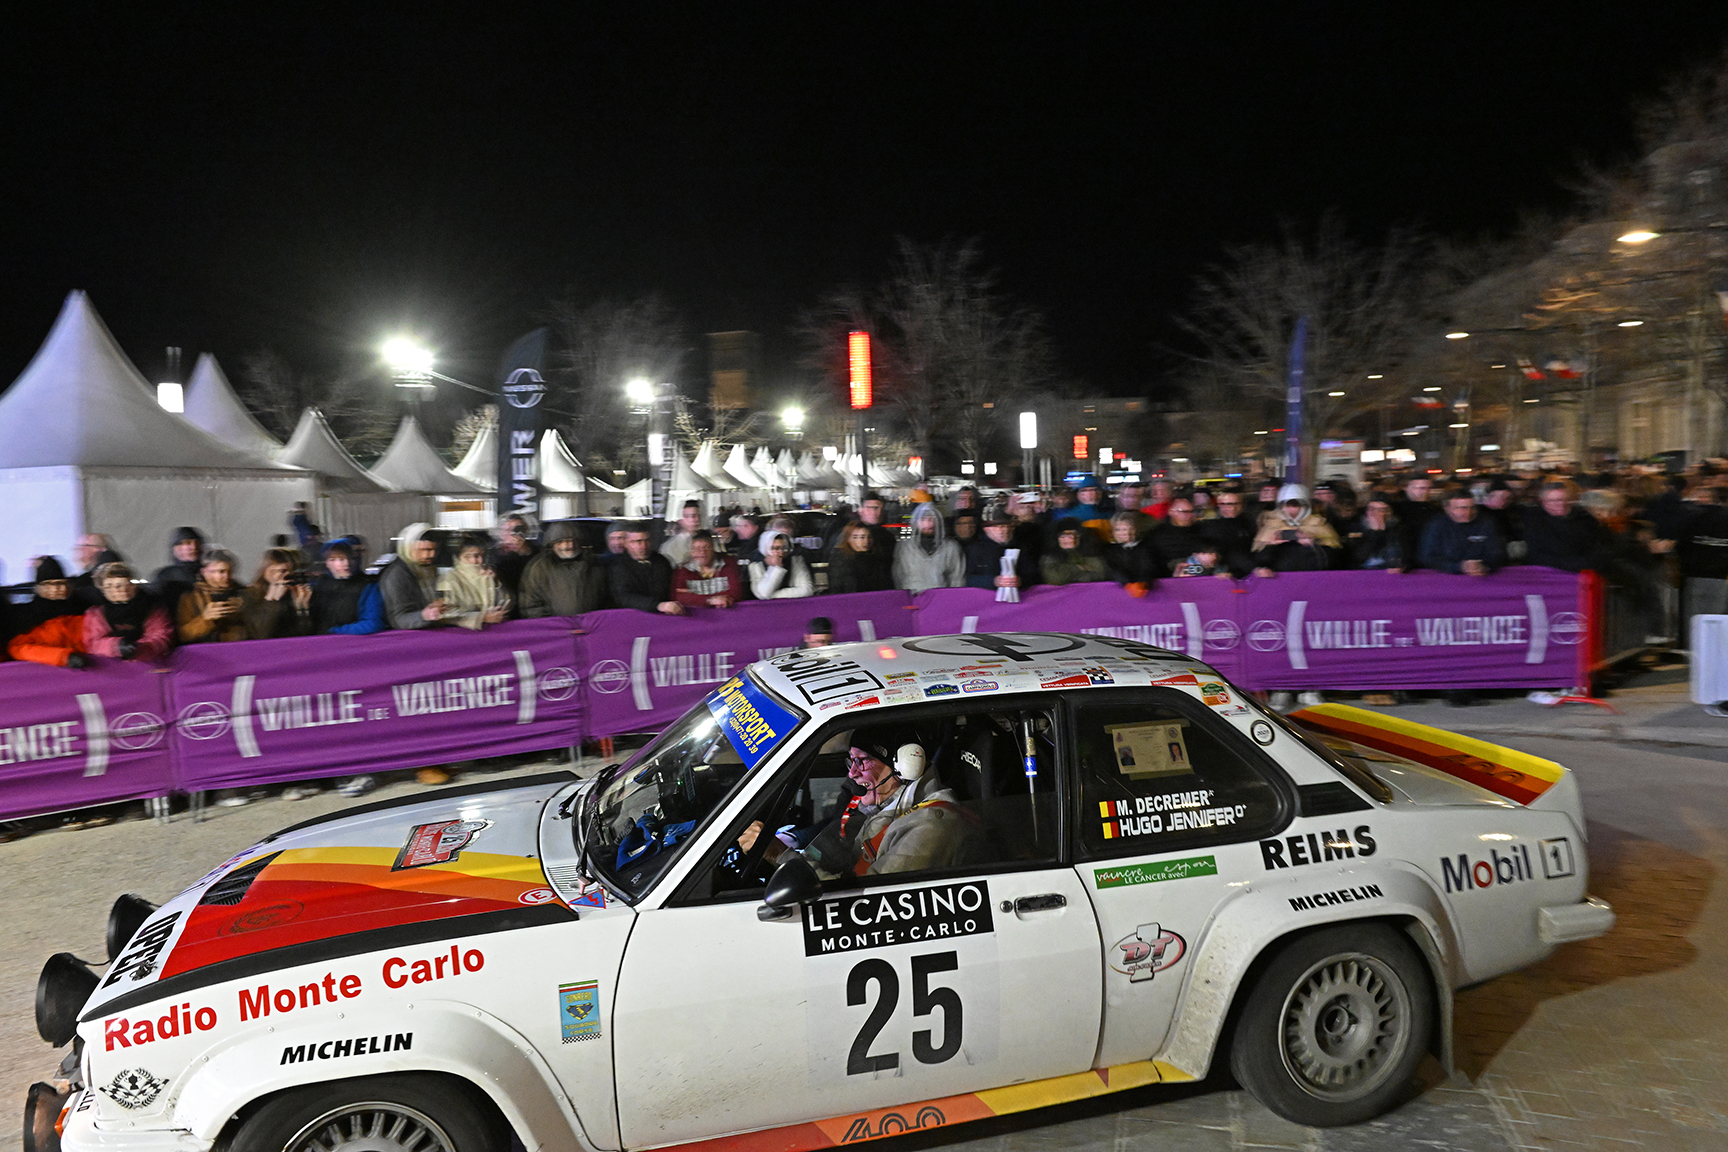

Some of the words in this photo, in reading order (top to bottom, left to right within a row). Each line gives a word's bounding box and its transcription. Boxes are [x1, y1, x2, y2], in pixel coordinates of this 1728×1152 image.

[1305, 619, 1392, 648] VILLE
[1416, 615, 1528, 646] VALENCE
[649, 652, 735, 688] VILLE
[255, 690, 365, 731] VILLE
[391, 674, 516, 717] VALENCE
[723, 689, 776, 745] MOTORSPORT
[1116, 799, 1133, 816] M.
[1135, 790, 1210, 815] DECREMER
[1119, 815, 1162, 837] HUGO
[1166, 806, 1236, 831] JENNIFER
[1259, 825, 1377, 870] REIMS
[1096, 868, 1144, 882] vaincre
[1124, 876, 1133, 884] LE
[1135, 872, 1166, 882] CANCER
[1168, 872, 1185, 880] avec
[1440, 844, 1533, 893] Mobil
[1549, 845, 1564, 872] 1
[807, 902, 842, 932] LE
[850, 885, 982, 926] CASINO
[1288, 884, 1383, 912] MICHELIN
[100, 911, 184, 990] OPEL
[821, 930, 895, 952] MONTE
[910, 919, 977, 940] CARLO
[1120, 935, 1174, 965] DT
[104, 1002, 217, 1052] Radio
[239, 969, 362, 1022] Monte
[383, 945, 485, 990] Carlo
[846, 951, 963, 1076] 25
[280, 1033, 413, 1066] MICHELIN
[841, 1106, 946, 1142] 400
